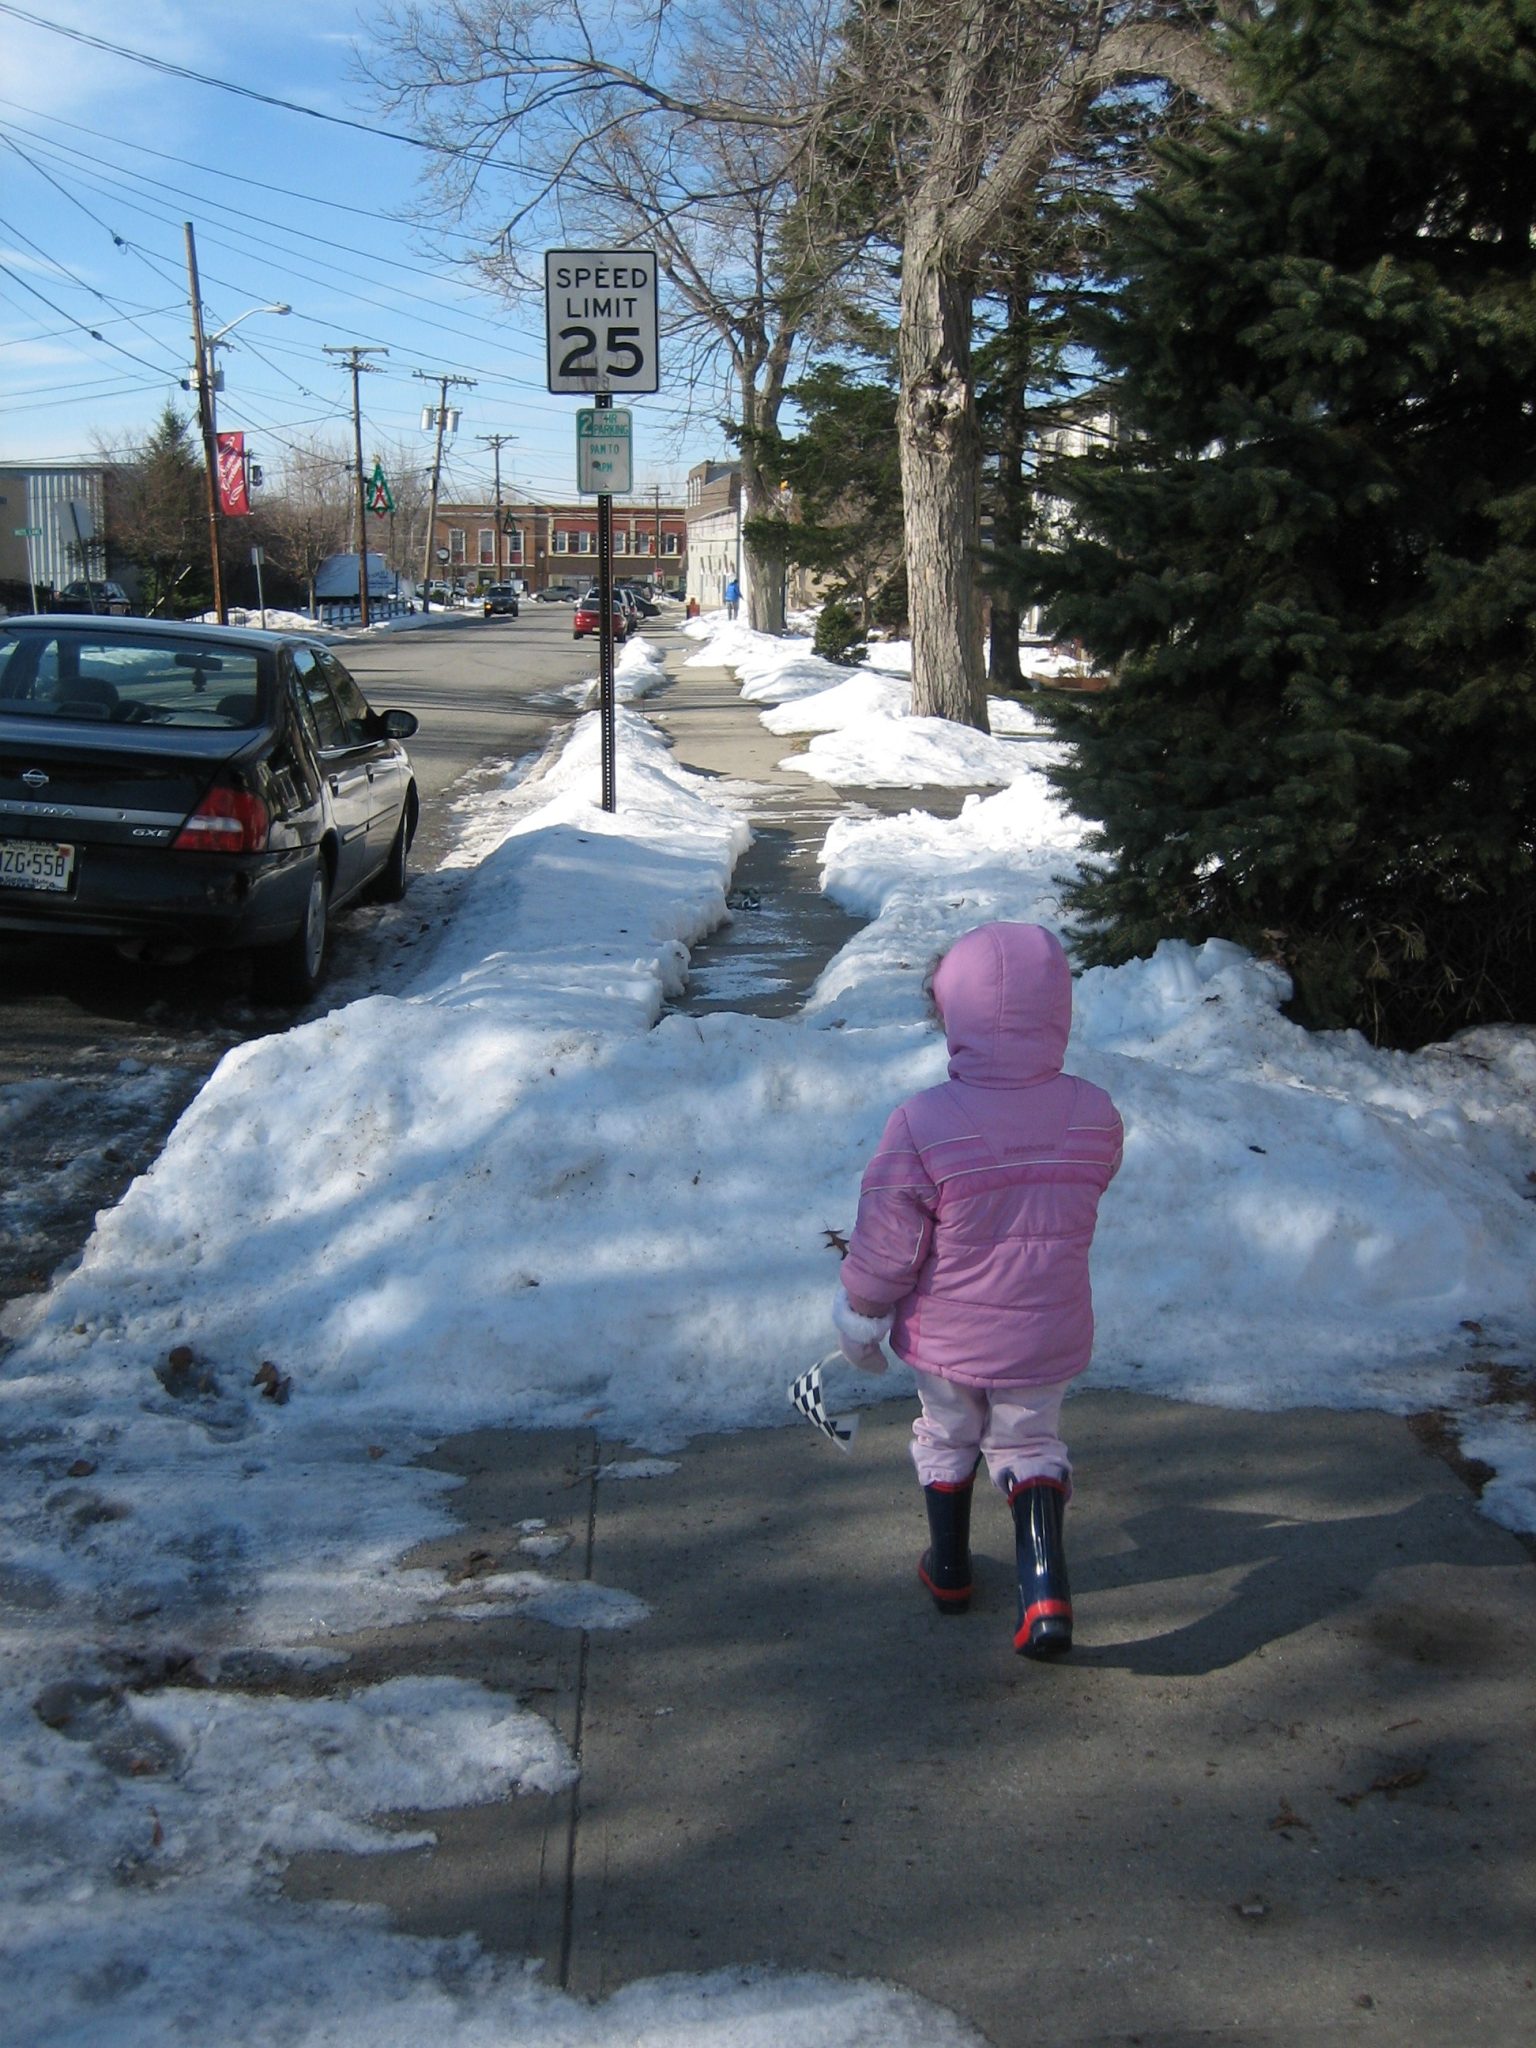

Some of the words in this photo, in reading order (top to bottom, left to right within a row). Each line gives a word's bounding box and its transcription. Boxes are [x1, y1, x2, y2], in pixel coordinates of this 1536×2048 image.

[556, 268, 648, 289] SPEED
[567, 298, 637, 318] LIMIT
[558, 326, 644, 378] 25
[581, 414, 592, 434] 2
[594, 424, 629, 435] PARKING
[608, 443, 620, 455] TO
[2, 803, 77, 816] LTIMA
[132, 828, 171, 838] GXE
